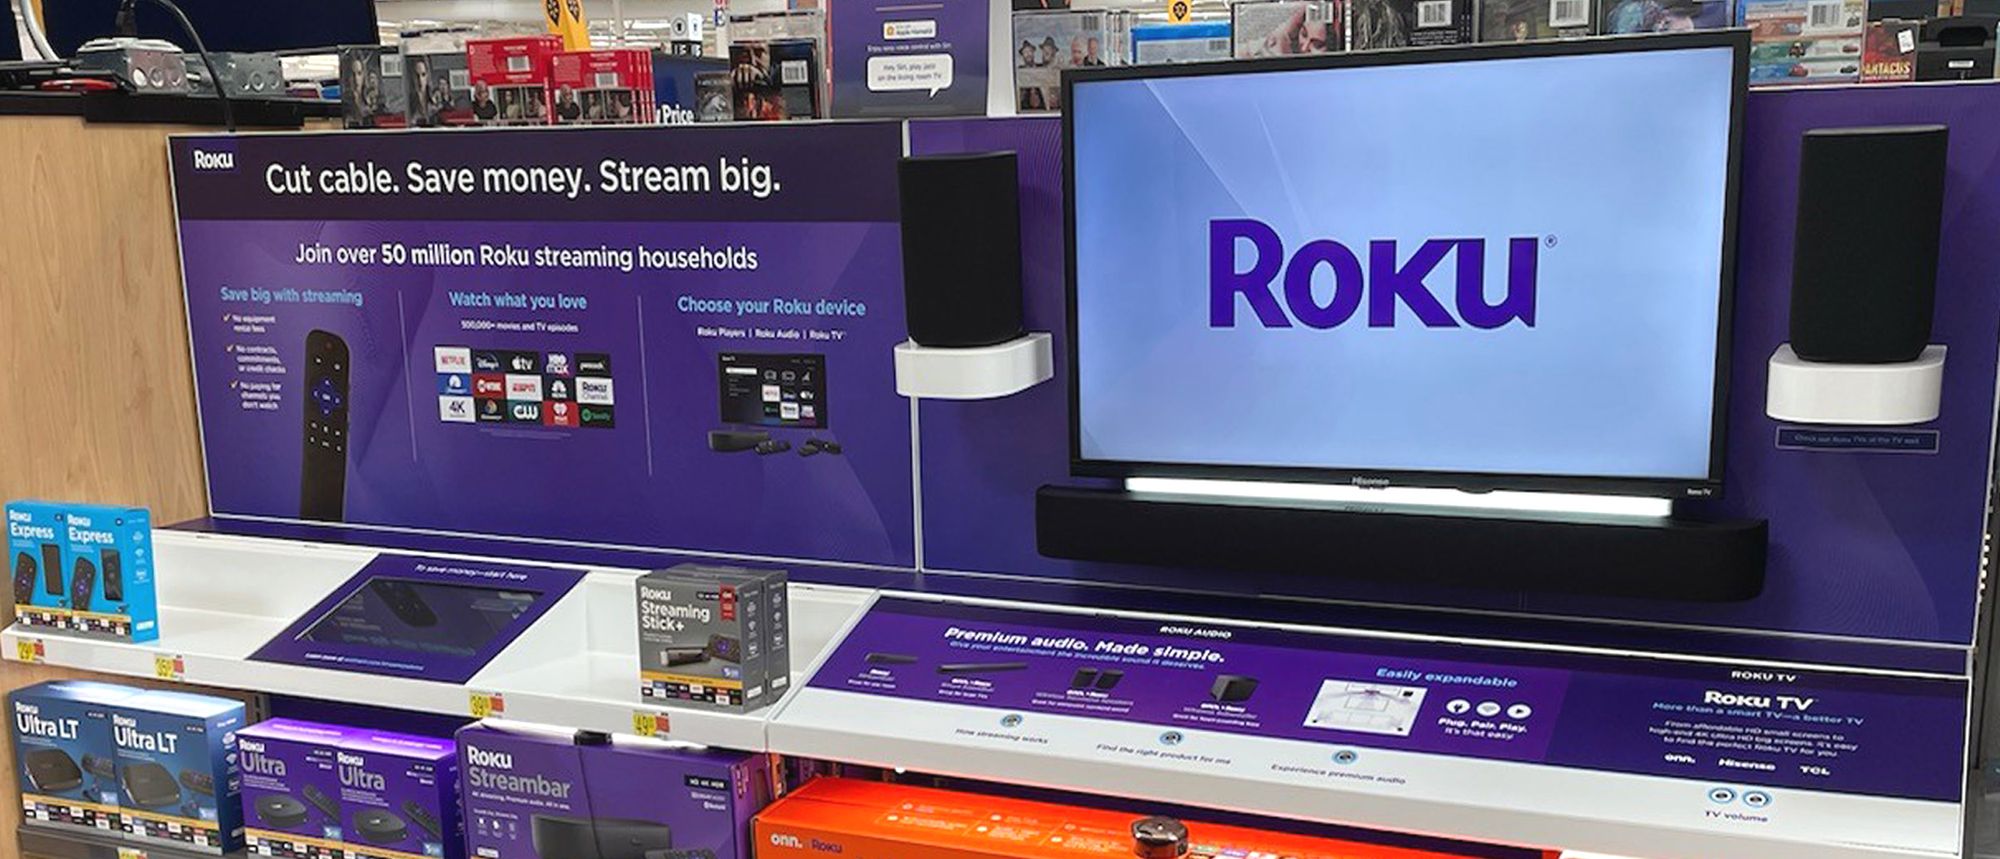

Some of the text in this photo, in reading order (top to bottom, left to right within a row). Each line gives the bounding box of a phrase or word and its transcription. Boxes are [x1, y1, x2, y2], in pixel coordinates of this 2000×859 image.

[662, 104, 695, 124] Price
[265, 157, 781, 198] Cut cable. Save money. Stream big.
[295, 243, 759, 272] Join over 50 million Roku streaming households
[220, 286, 364, 306] Save big with streaming
[448, 291, 588, 311] Watch what you love
[677, 295, 867, 316] Choose your Roku device
[497, 321, 521, 332] movies
[522, 321, 536, 332] and
[536, 321, 546, 332] TV
[547, 324, 579, 333] episodes
[697, 326, 717, 337] Roku
[718, 327, 746, 338] Players
[755, 329, 775, 339] Roku
[776, 328, 800, 339] Audio
[809, 330, 830, 340] Roku
[10, 521, 55, 541] Express
[68, 526, 115, 546] Express
[415, 563, 427, 572] To
[428, 566, 447, 574] save
[506, 571, 527, 581] here
[641, 600, 711, 623] Streaming
[641, 615, 685, 632] Stick+
[1159, 625, 1233, 639] ROKU AUDIO
[944, 626, 1225, 663] Premium audio. Made simple.
[970, 643, 991, 652] your
[1375, 667, 1518, 688] Easily expandable
[1731, 670, 1797, 683] ROKU TV
[1652, 701, 1684, 711] More
[1686, 703, 1714, 714] than
[1726, 708, 1763, 719] smart
[1803, 713, 1842, 724] better
[1845, 717, 1864, 726] TV
[16, 713, 80, 740] Ultra LT
[1438, 717, 1528, 734] Plug. Pair. Play.
[1462, 728, 1486, 738] that
[1487, 731, 1515, 742] easy
[114, 725, 178, 754] Ultra LT
[1022, 735, 1049, 745] works
[240, 750, 287, 777] Ultra
[1664, 752, 1696, 764] onn.
[1718, 757, 1776, 772] Hisense
[338, 763, 385, 791] Ultra
[1271, 763, 1407, 785] Experience premium audio
[1799, 765, 1831, 777] TCL
[468, 765, 572, 799] Streambar
[1704, 809, 1768, 823] TV volume
[769, 832, 803, 849] onn.
